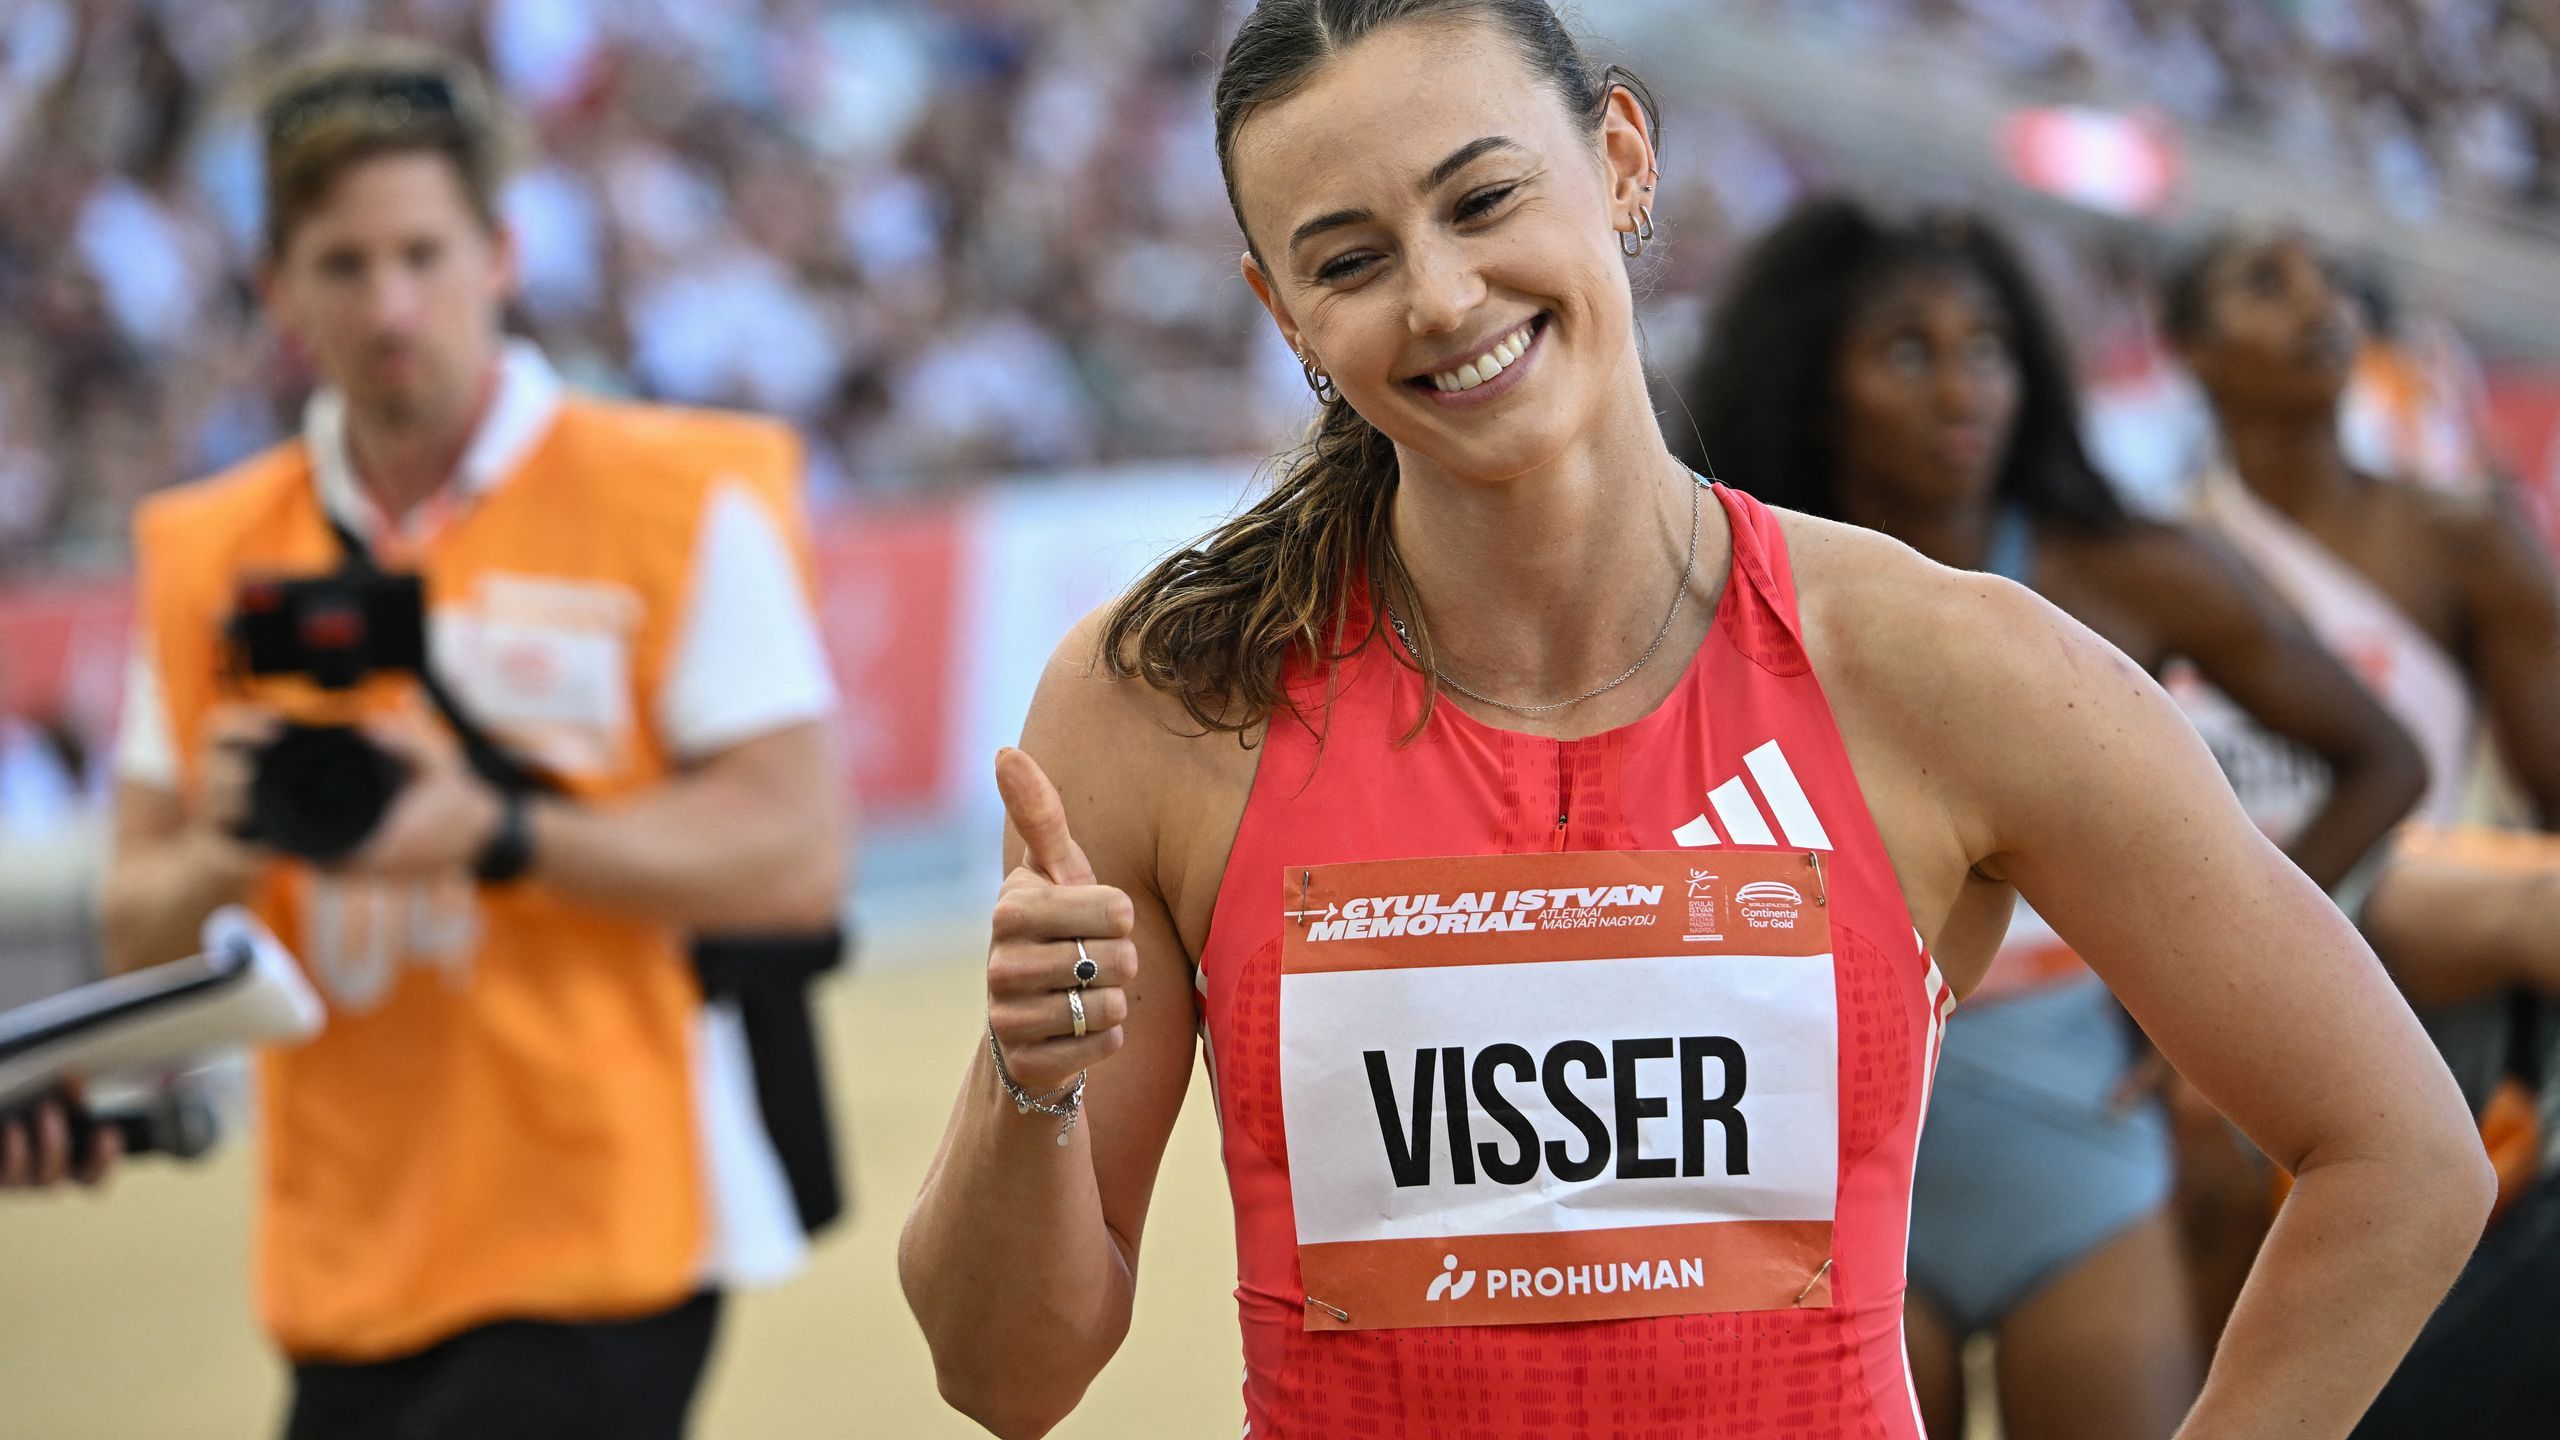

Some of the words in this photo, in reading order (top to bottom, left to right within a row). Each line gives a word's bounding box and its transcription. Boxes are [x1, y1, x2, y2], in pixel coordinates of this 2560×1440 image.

[1341, 891, 1496, 920] GYULAI
[1502, 884, 1664, 911] ISTVÁN
[1538, 907, 1602, 920] ATLÉTIKAI
[1741, 907, 1798, 919] Continental
[1306, 910, 1537, 942] MEMORIAL
[1541, 917, 1597, 930] MAGYAR
[1599, 914, 1656, 928] NAGYDÍJ
[1747, 918, 1769, 928] Tour
[1770, 918, 1794, 929] Gold
[1362, 1035, 1750, 1188] VISSER
[1487, 1258, 1704, 1299] PROHUMAN
